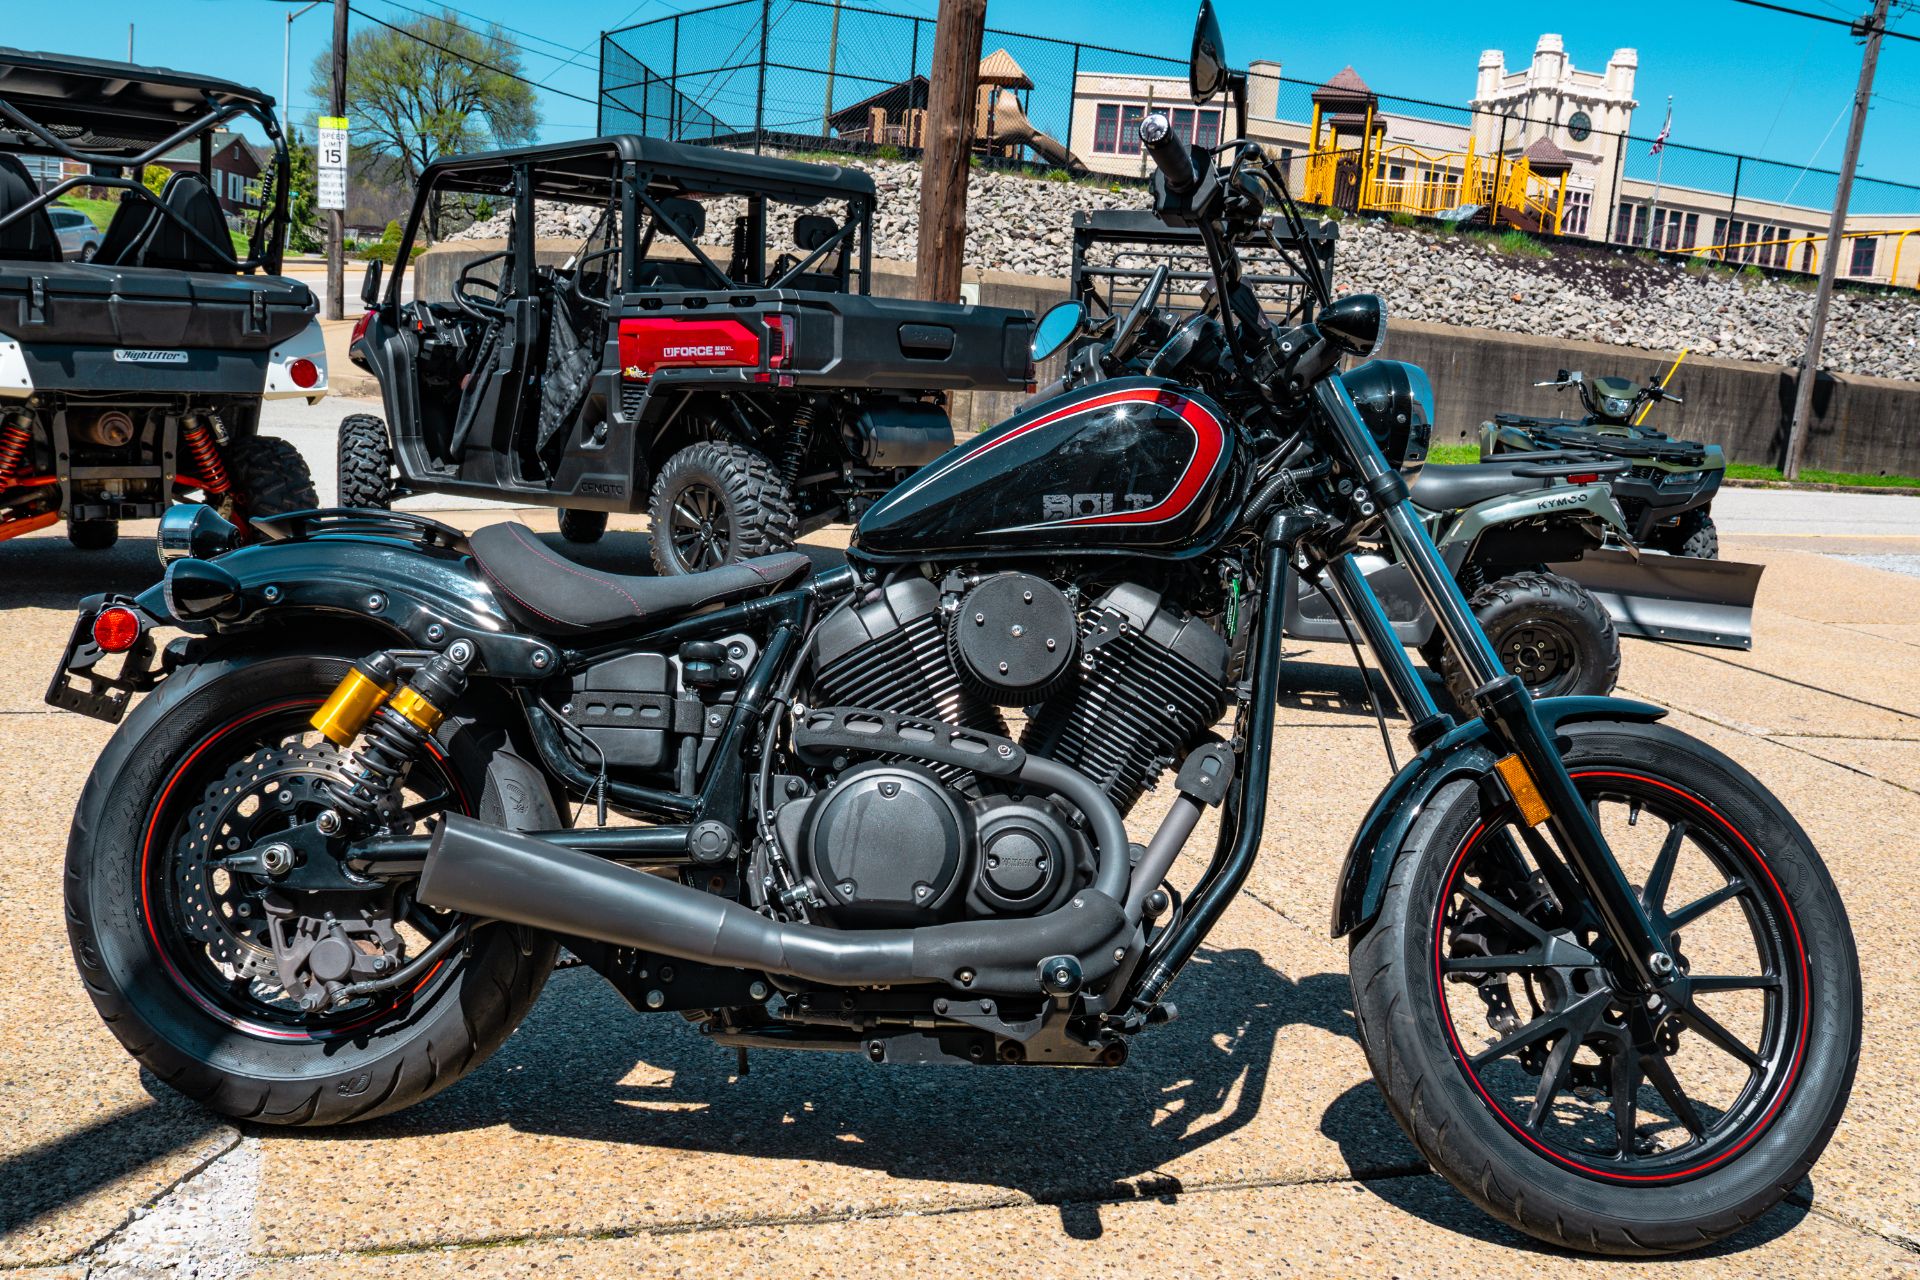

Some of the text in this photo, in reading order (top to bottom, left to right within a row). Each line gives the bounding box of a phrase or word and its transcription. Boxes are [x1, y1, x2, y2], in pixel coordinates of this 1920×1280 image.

[321, 132, 346, 140] SPEED
[325, 149, 341, 164] 15
[1042, 493, 1153, 520] BOLT
[1537, 494, 1588, 510] KYMCO
